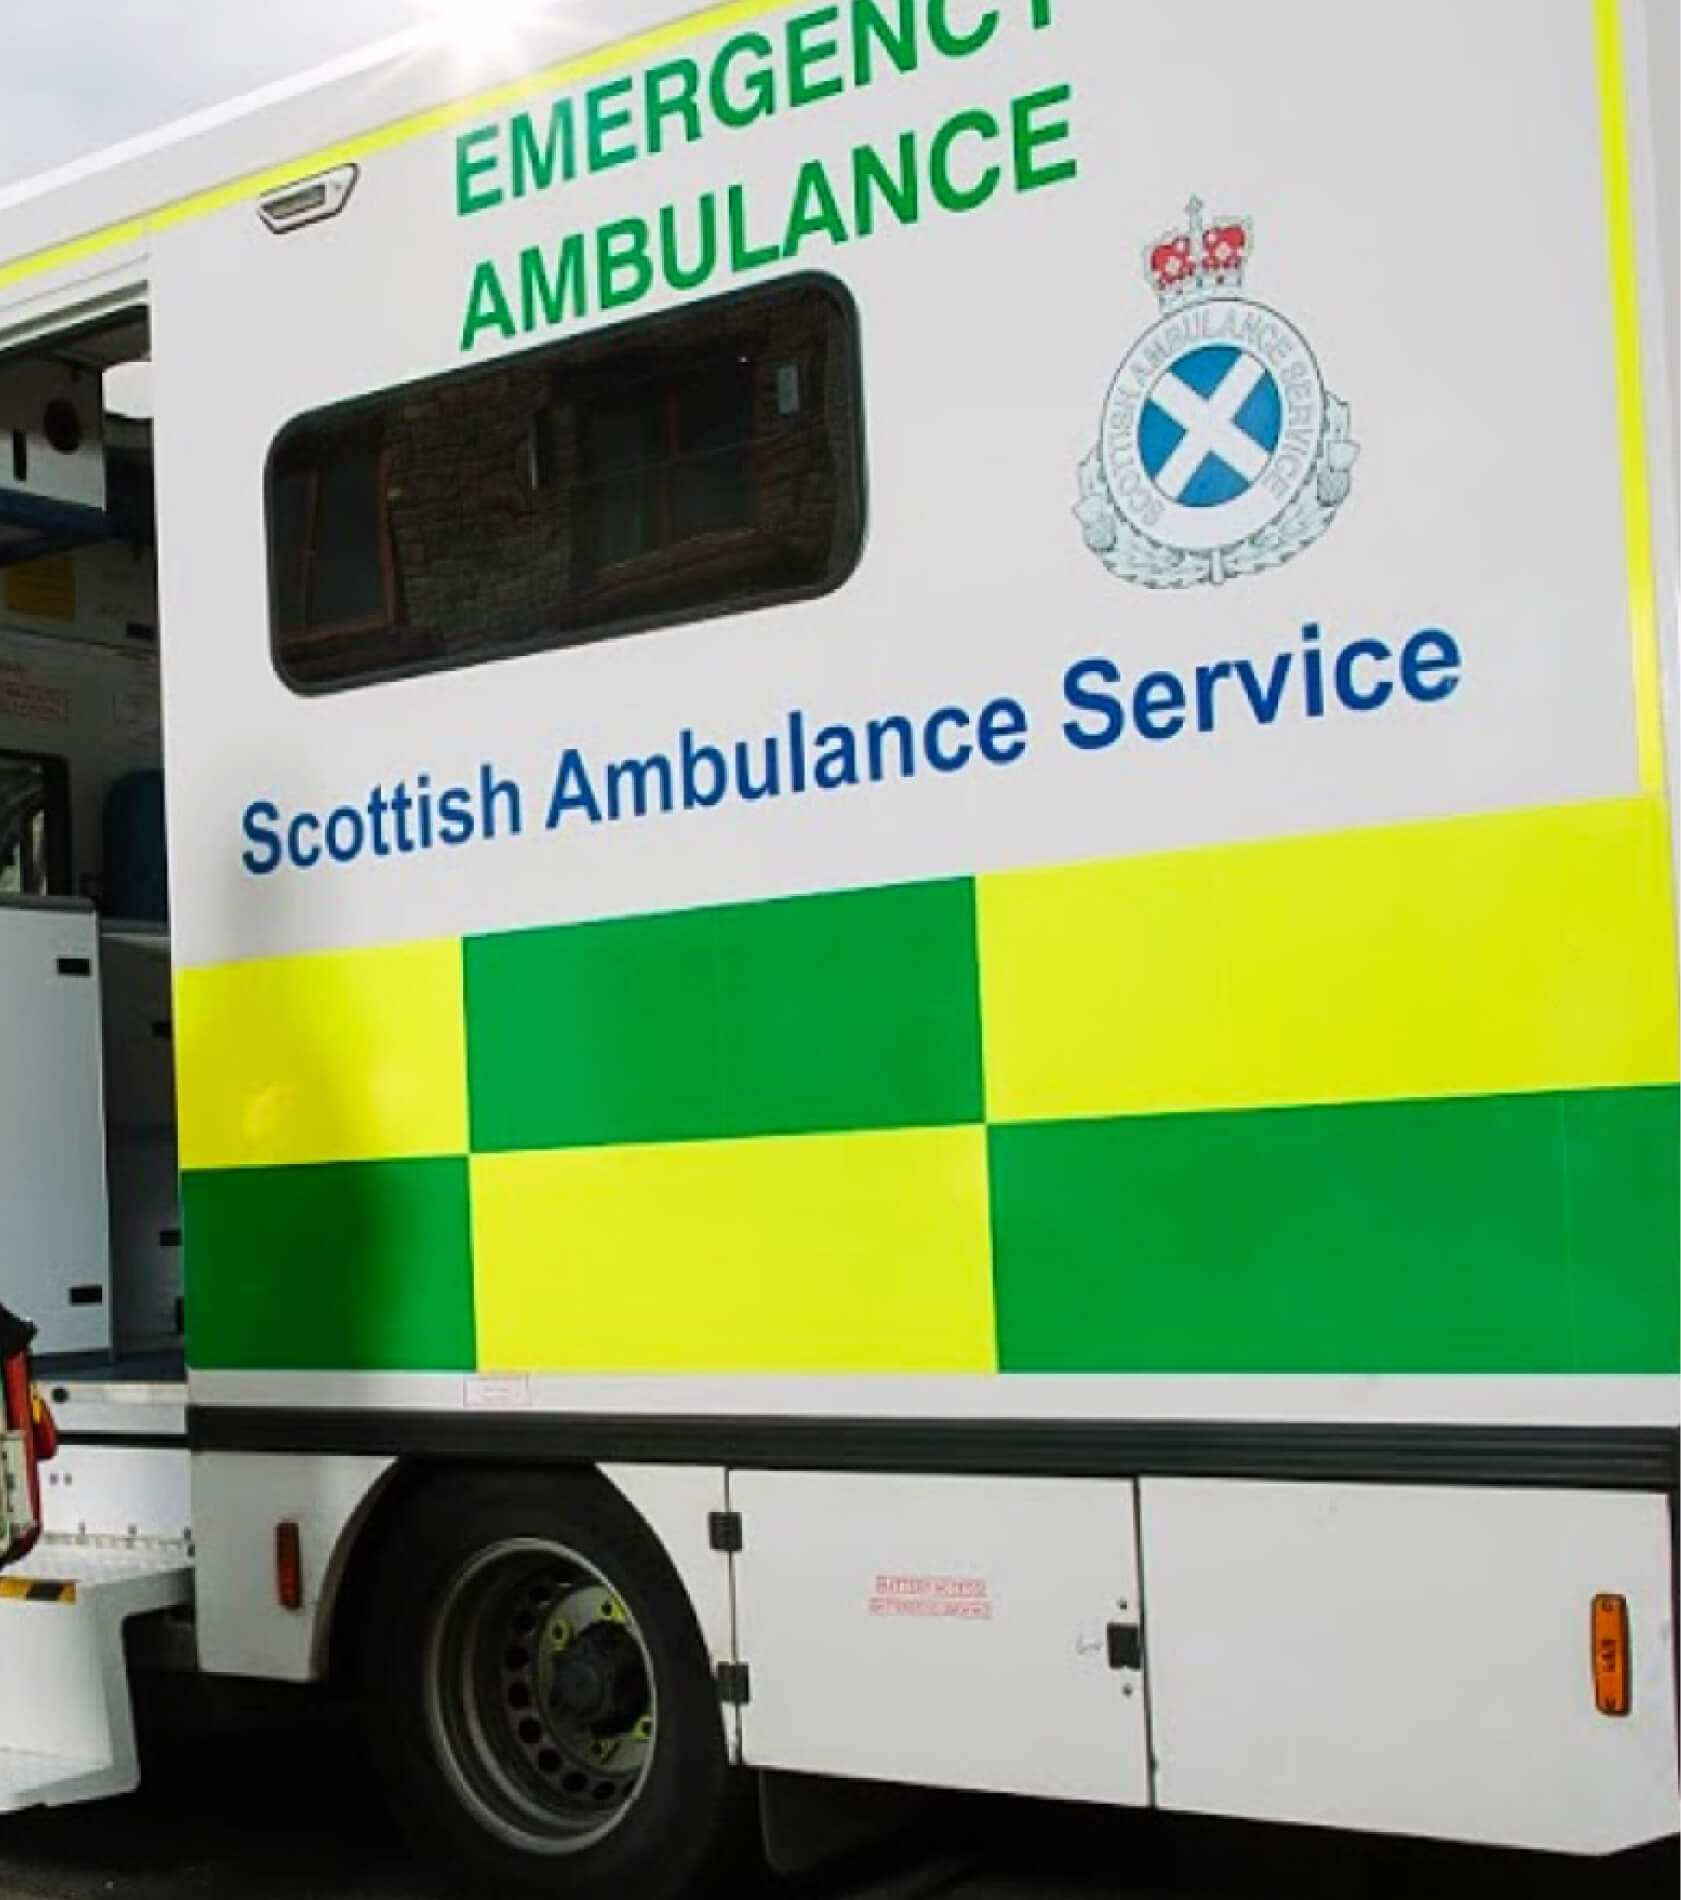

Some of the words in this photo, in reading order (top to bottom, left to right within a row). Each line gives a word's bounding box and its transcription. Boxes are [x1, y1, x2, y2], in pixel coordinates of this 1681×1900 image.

[458, 81, 1080, 352] AMBULANCE
[1129, 308, 1294, 387] AMBULANCE
[1108, 386, 1167, 526] SCOTTISH
[1267, 360, 1315, 498] SERVICE
[243, 748, 522, 873] Scottish
[546, 696, 1030, 831] Ambulance
[1062, 624, 1465, 753] Service
